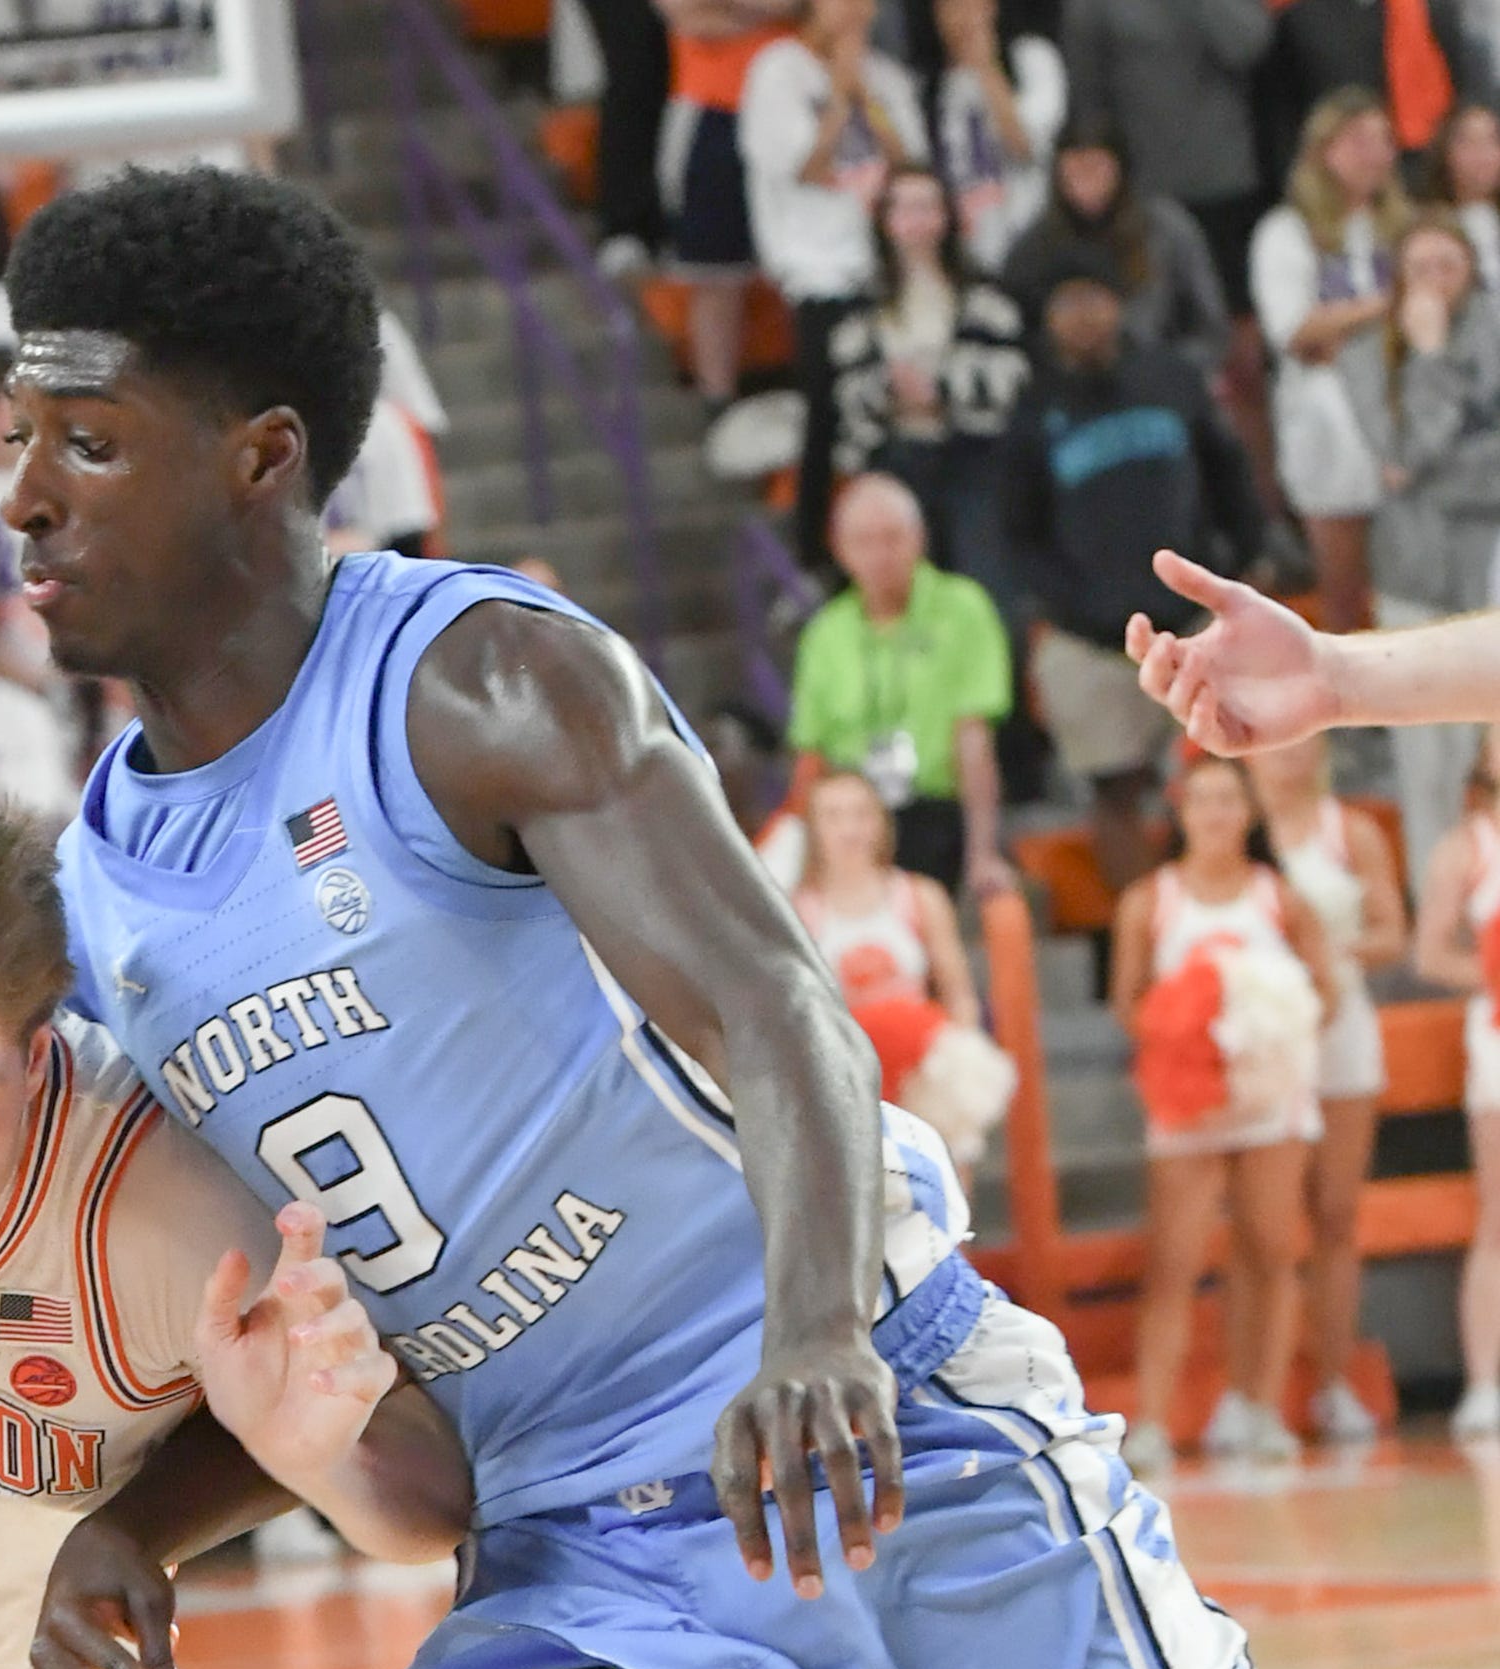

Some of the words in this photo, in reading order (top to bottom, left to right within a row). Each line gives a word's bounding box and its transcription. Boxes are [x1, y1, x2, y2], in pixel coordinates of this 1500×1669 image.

[159, 966, 391, 1129] NORTH
[255, 1091, 448, 1296] 9
[390, 1189, 627, 1381] ROLINA
